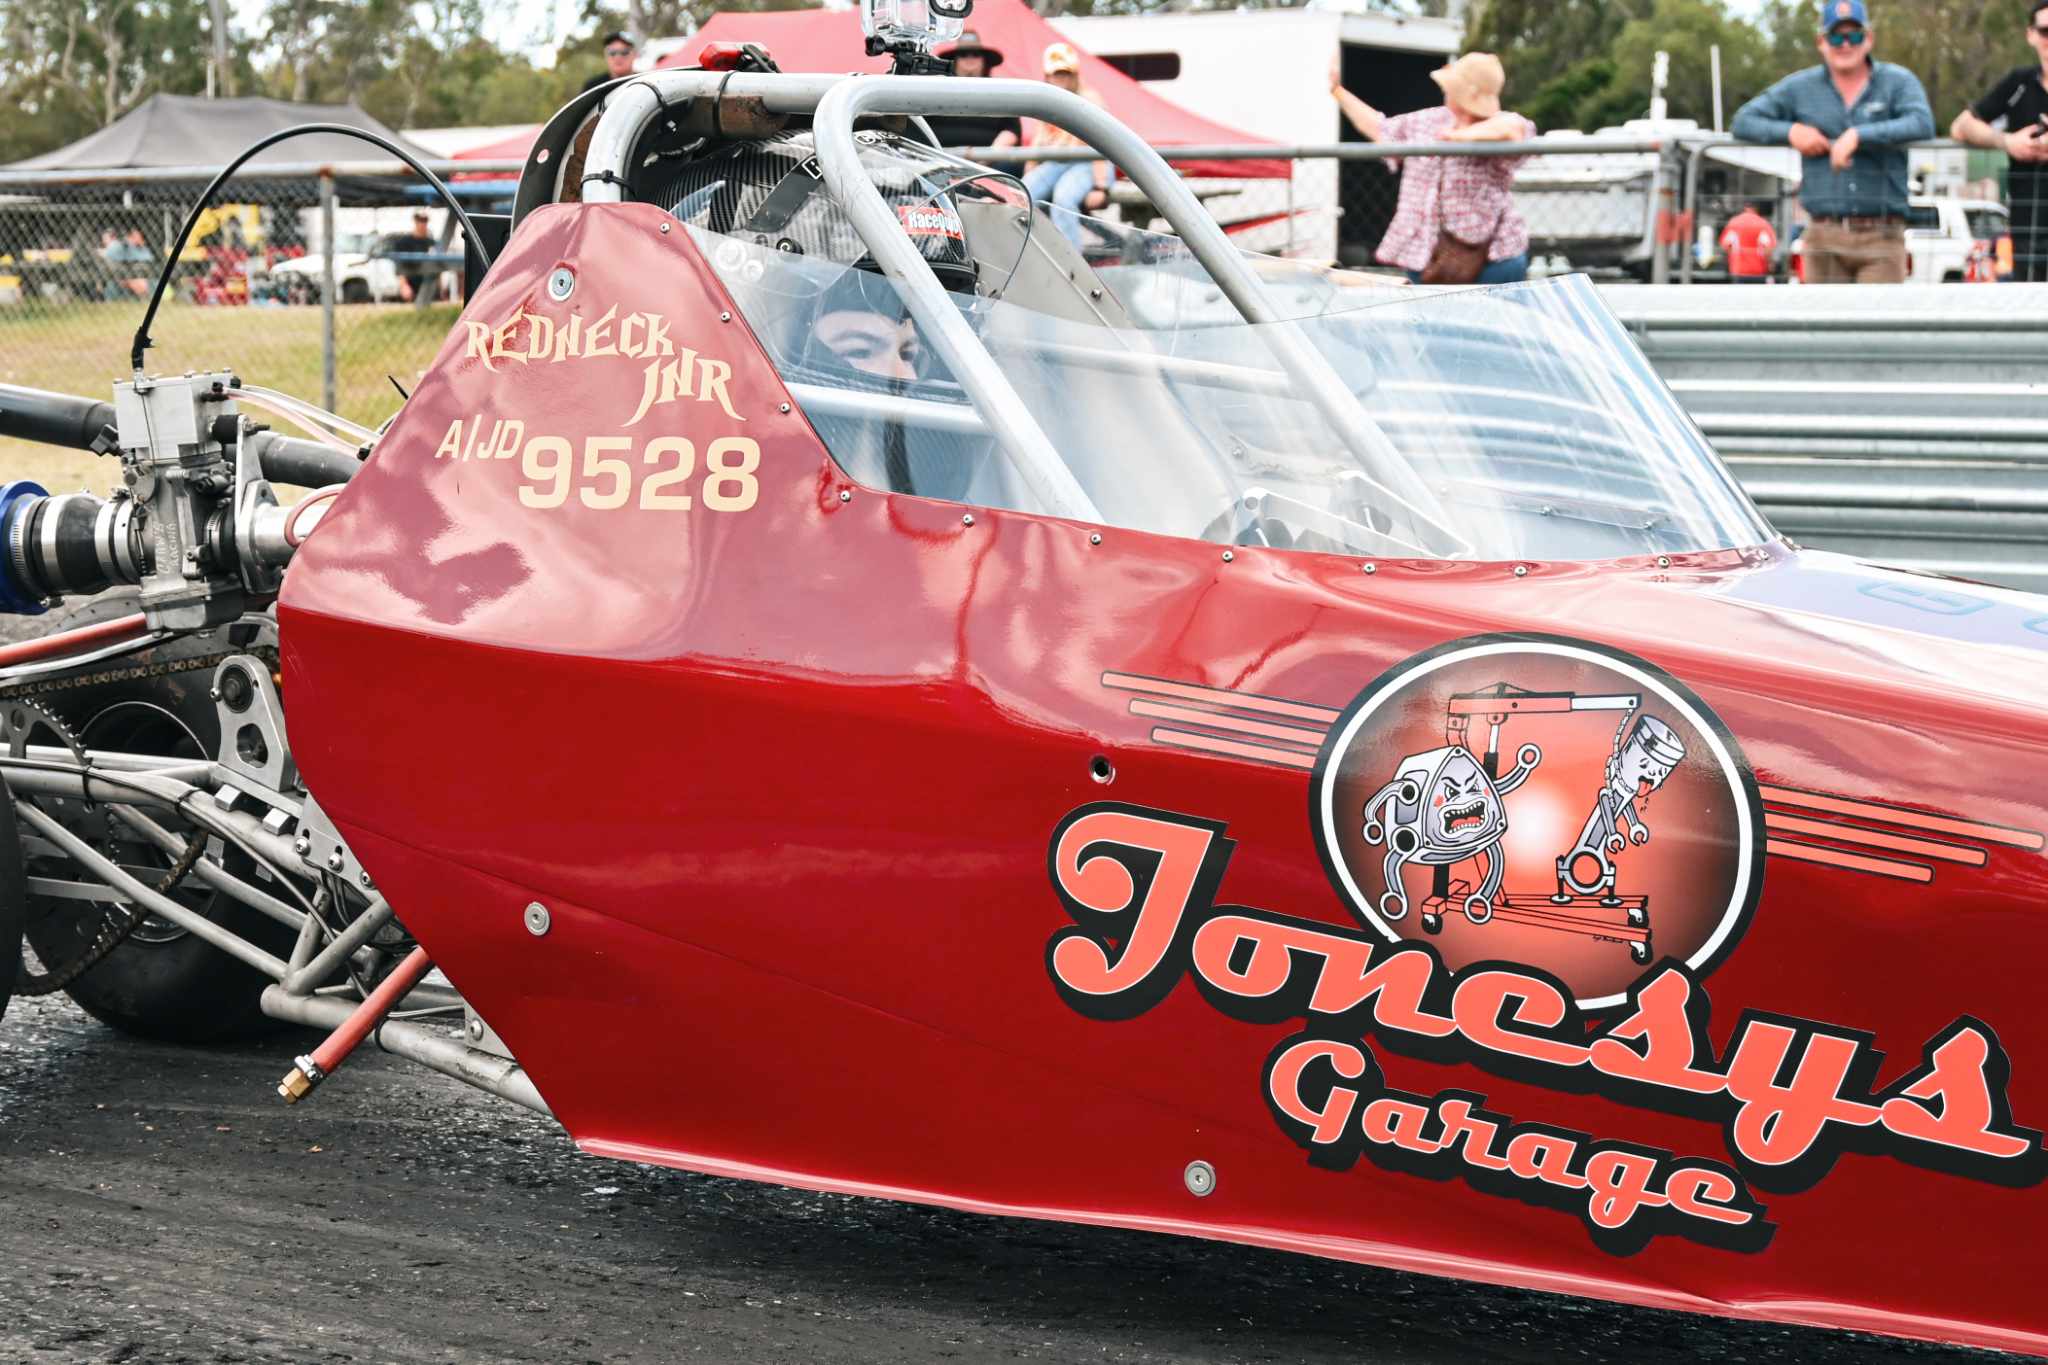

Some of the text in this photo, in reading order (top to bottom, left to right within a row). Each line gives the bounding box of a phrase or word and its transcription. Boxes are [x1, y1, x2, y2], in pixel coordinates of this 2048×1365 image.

[463, 303, 676, 374] REDNECK
[620, 346, 748, 428] JNR
[434, 413, 761, 512] A/JD 9528
[1052, 811, 2031, 1166] Jonesys
[1269, 1039, 1753, 1229] Garage
